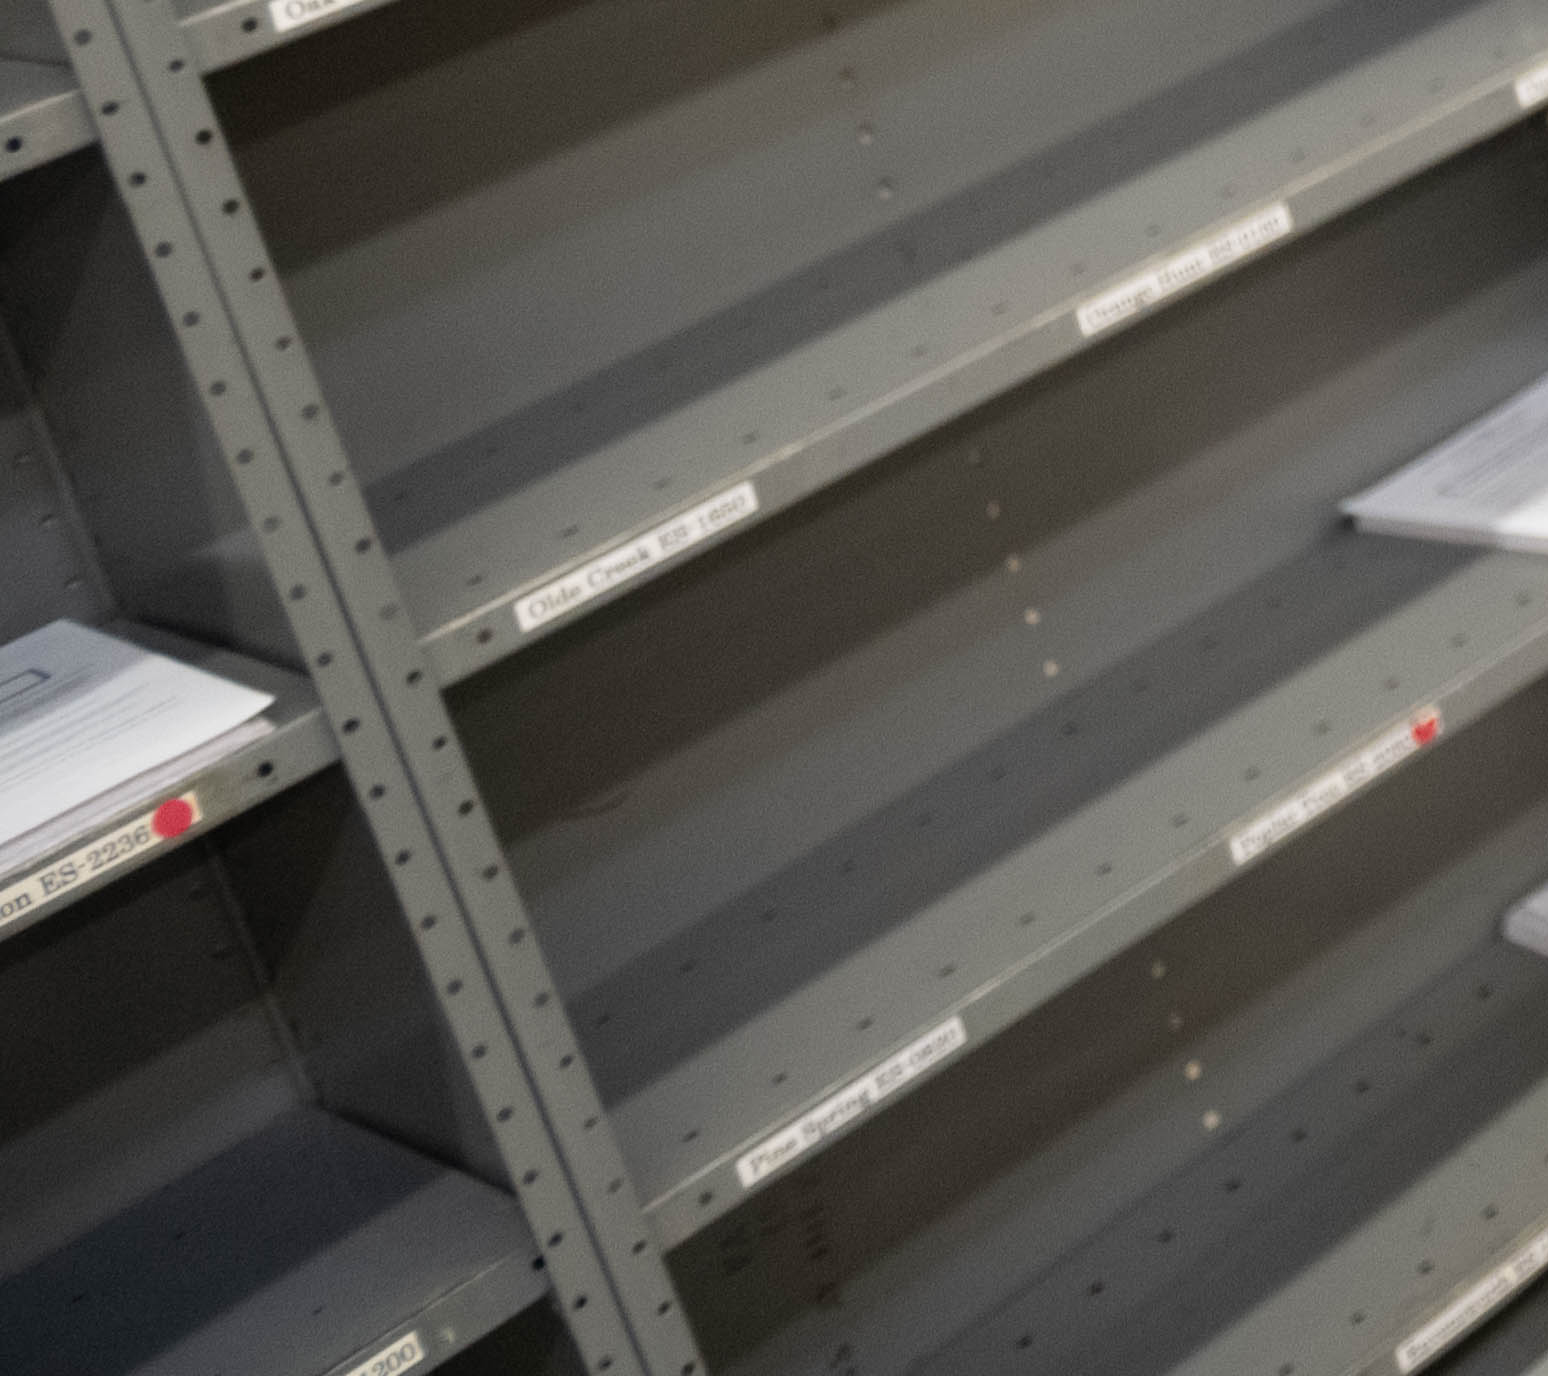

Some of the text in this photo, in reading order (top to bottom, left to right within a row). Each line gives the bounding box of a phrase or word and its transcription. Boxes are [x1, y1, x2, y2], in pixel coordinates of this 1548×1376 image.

[524, 579, 584, 621] Olde
[583, 543, 653, 589] Creek
[36, 823, 152, 895] ES-2236
[360, 1342, 417, 1376] 200
